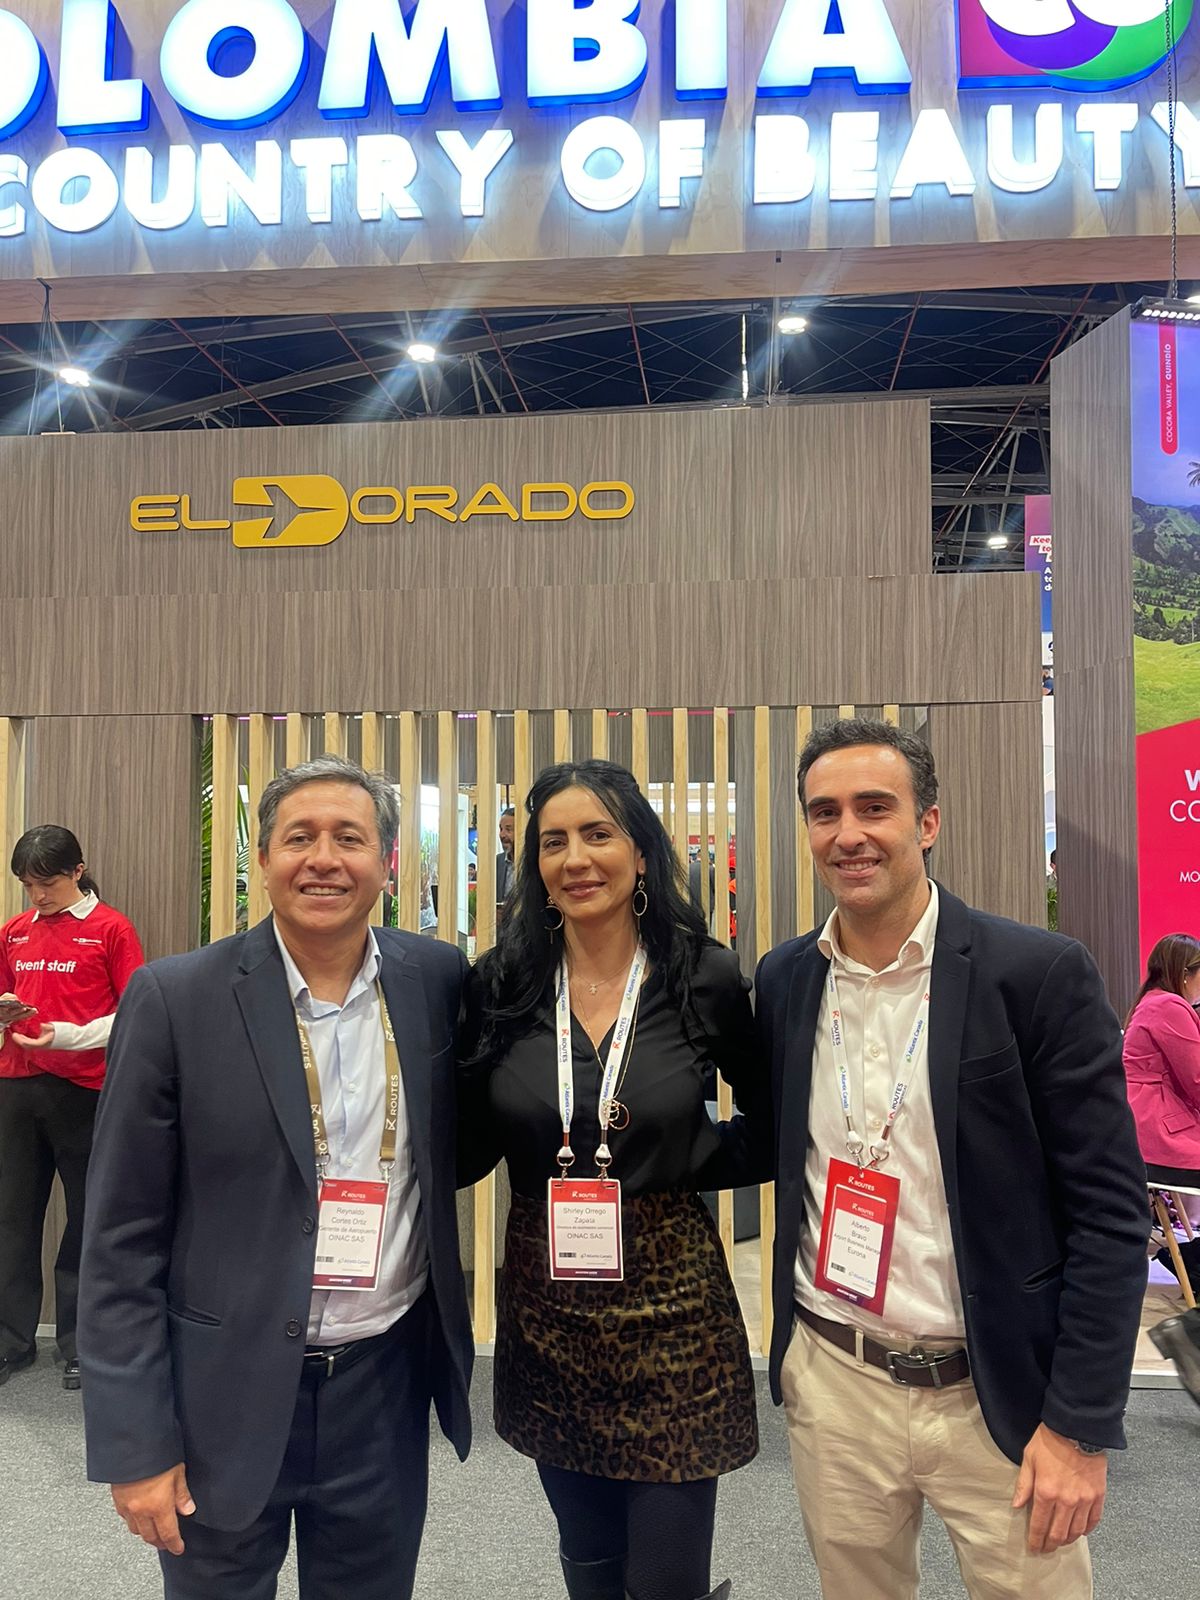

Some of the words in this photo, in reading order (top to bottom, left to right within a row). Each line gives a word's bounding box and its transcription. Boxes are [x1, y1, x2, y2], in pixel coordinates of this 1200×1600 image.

[0, 0, 911, 141] LOMBIA
[560, 115, 705, 211] OF
[753, 101, 1200, 204] BEAUTY
[130, 494, 231, 531] EL
[15, 959, 45, 972] Event
[47, 960, 77, 973] staff
[616, 1016, 627, 1041] ROUTES
[833, 1020, 841, 1046] ROUTES
[561, 1038, 569, 1063] ROUTES
[390, 1074, 398, 1116] ROUTES
[854, 1181, 875, 1191] ROUTES
[336, 1207, 365, 1216] Reynaldo
[563, 1207, 584, 1215] Shirley
[857, 1206, 875, 1216] ROUTES
[574, 1216, 596, 1224] Zapata
[851, 1220, 870, 1232] Alberto
[567, 1232, 589, 1240] OINAC
[851, 1230, 867, 1241] Bravo
